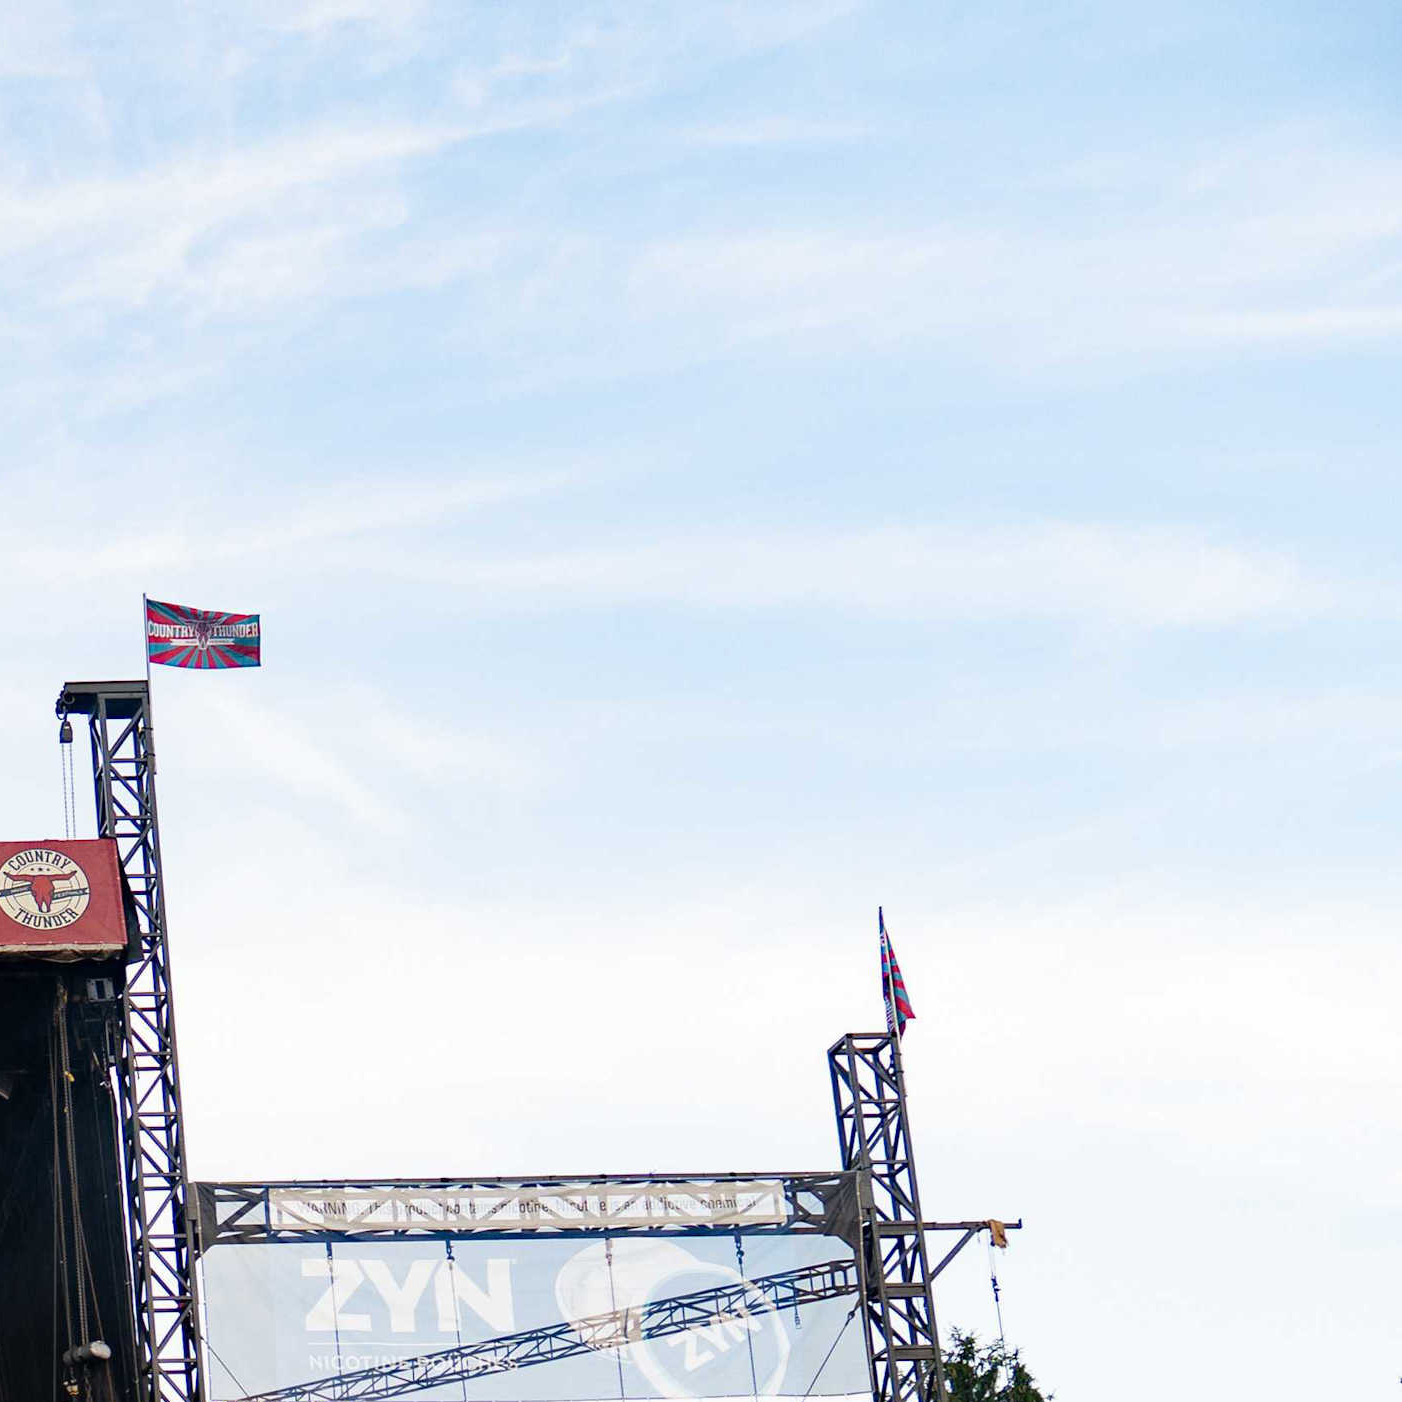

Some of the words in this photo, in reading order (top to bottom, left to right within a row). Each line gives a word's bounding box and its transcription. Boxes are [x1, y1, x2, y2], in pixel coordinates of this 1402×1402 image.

[147, 619, 195, 638] COUNTRY
[212, 621, 259, 638] THUNDER
[7, 850, 72, 872] COUNTRY
[13, 907, 79, 929] THUNDER
[300, 1257, 518, 1334] ZYN
[667, 1305, 763, 1372] ZYN
[308, 1354, 405, 1372] NICOTINE
